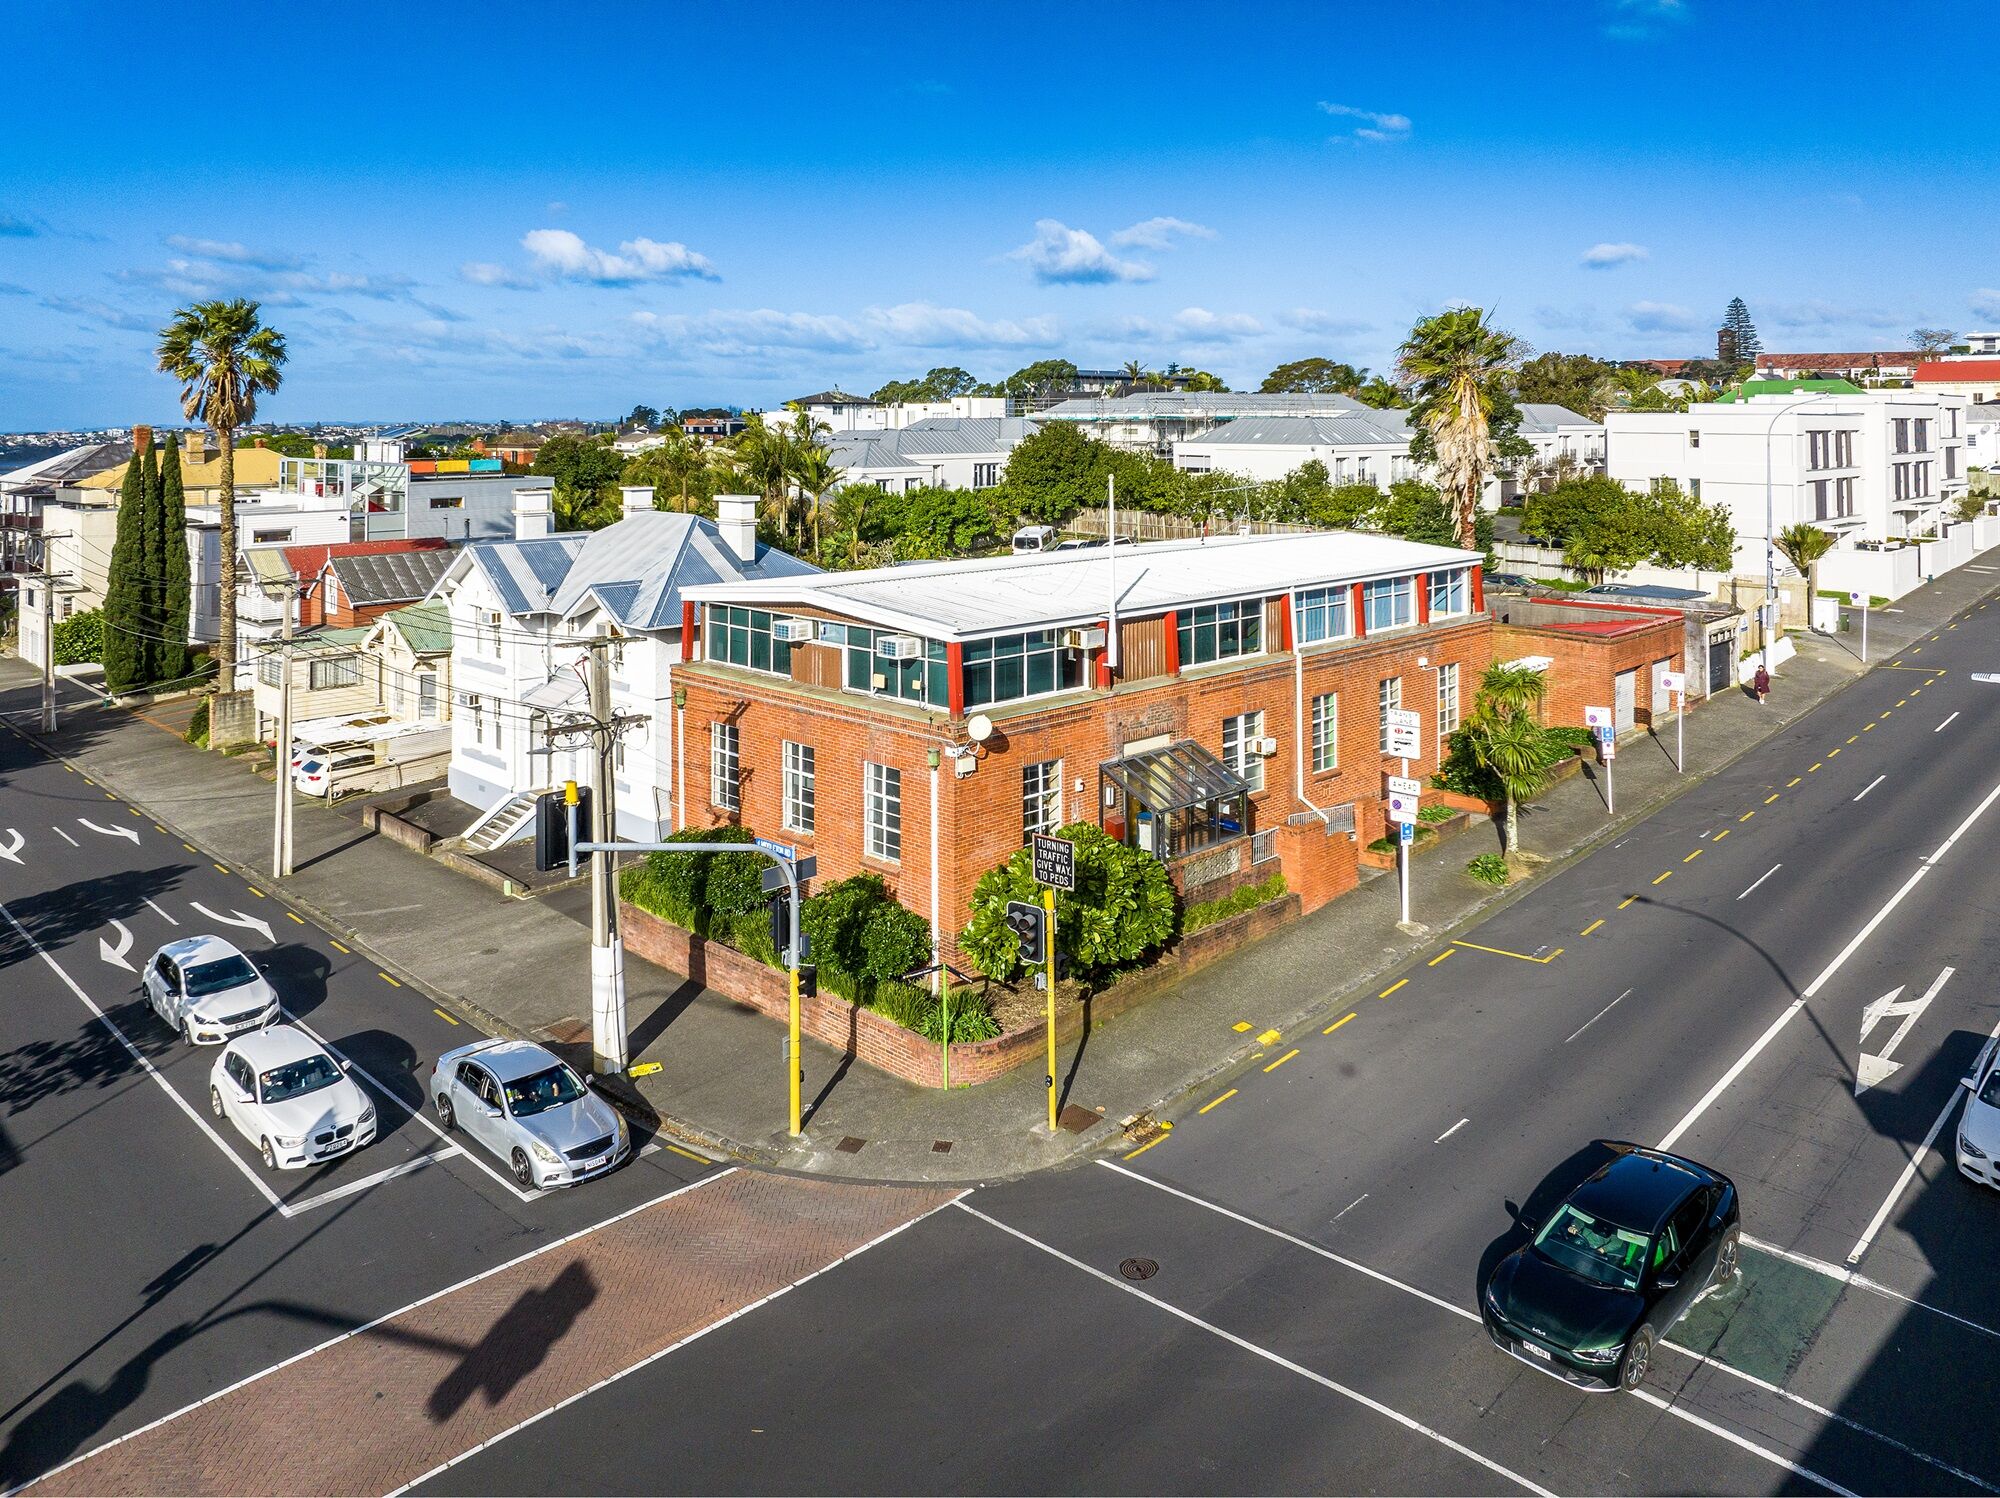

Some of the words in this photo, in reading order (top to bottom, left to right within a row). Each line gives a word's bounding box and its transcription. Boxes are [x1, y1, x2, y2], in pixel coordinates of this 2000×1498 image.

[1393, 780, 1417, 792] AHEAD
[1037, 838, 1069, 853] TURNING
[1039, 849, 1068, 865] TRAFFIC
[1036, 860, 1053, 871] GIVE
[1055, 863, 1071, 876] WAY
[1039, 870, 1048, 880] TO
[1050, 874, 1069, 886] PEDS
